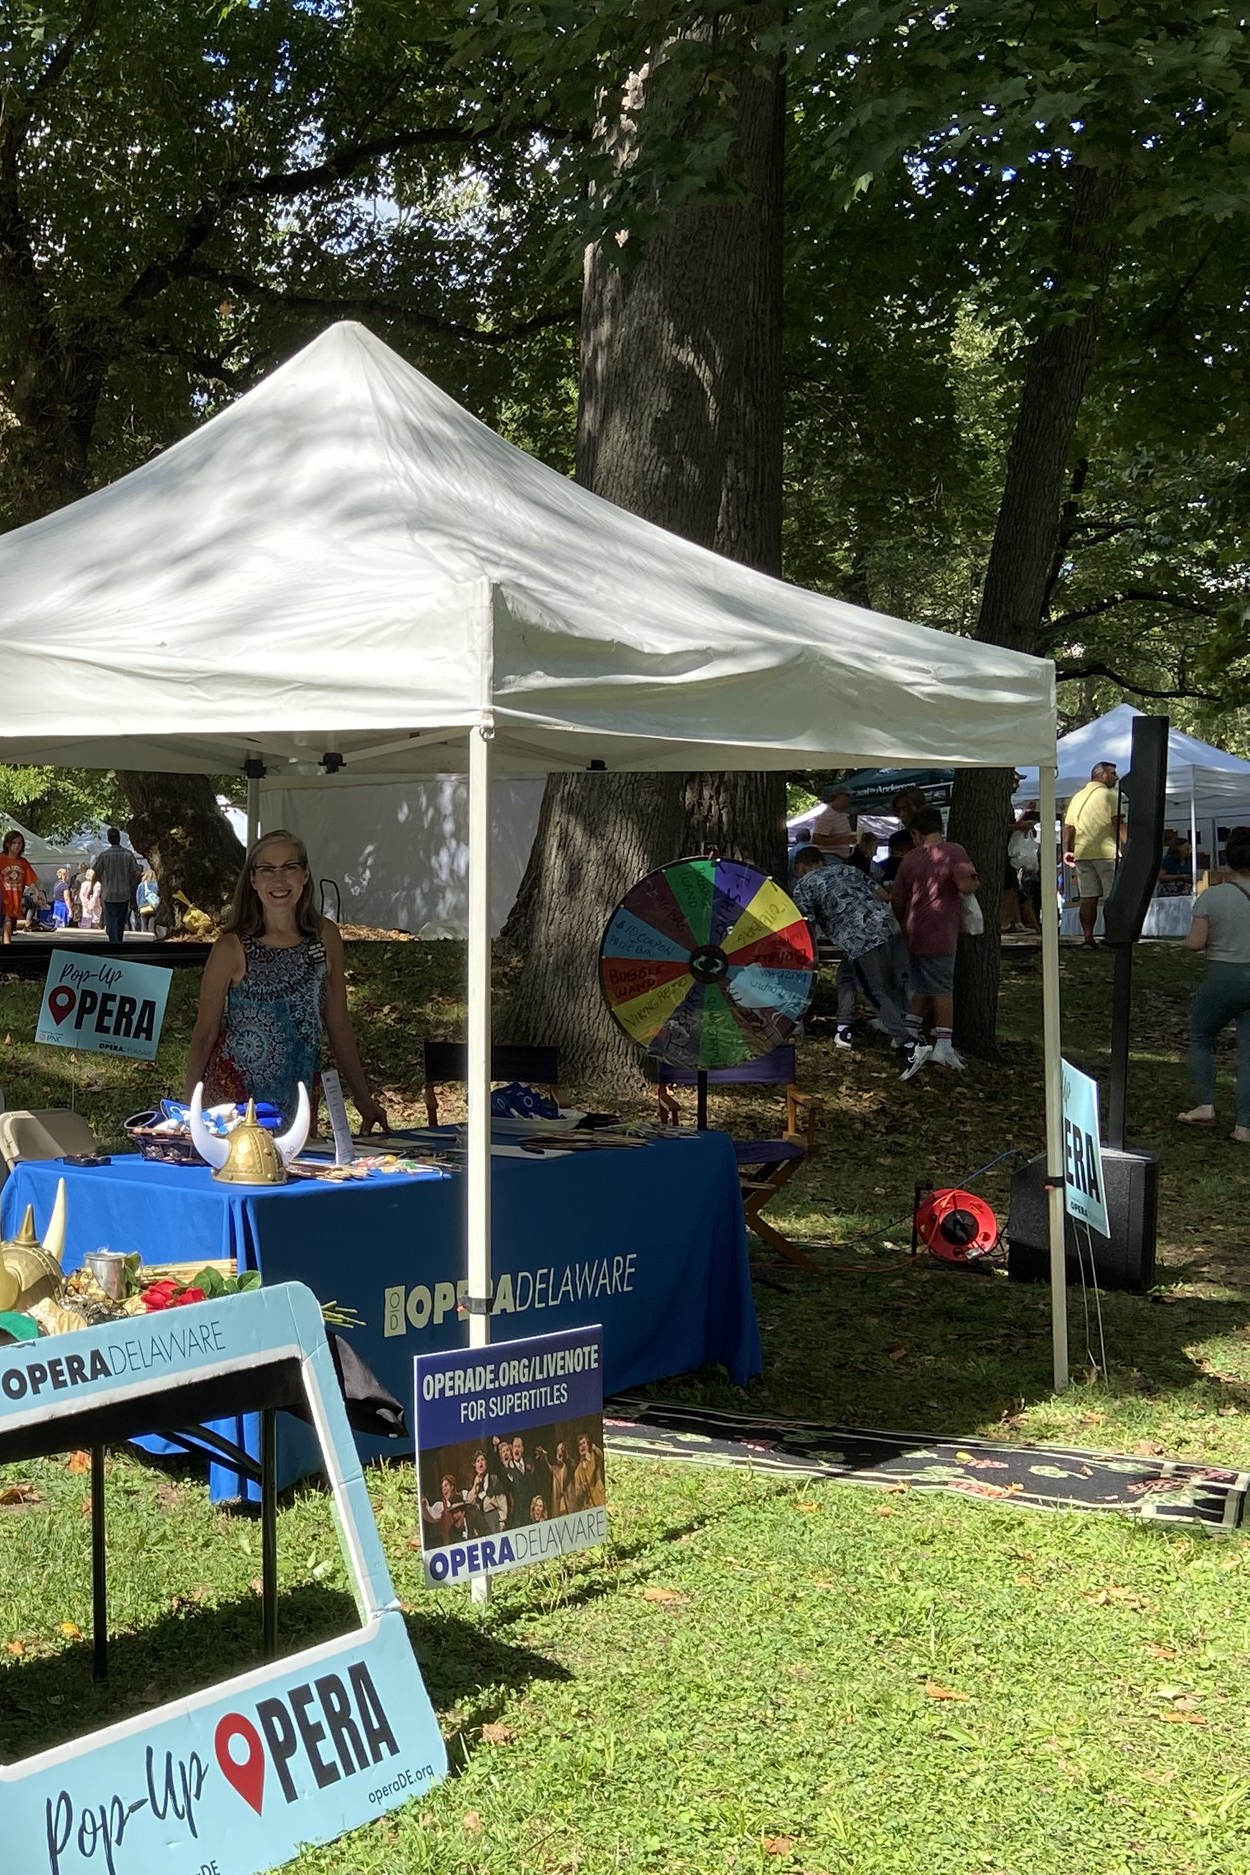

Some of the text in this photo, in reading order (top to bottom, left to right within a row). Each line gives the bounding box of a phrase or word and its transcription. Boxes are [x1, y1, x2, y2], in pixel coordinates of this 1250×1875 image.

[59, 963, 124, 990] Pop-Up
[609, 963, 664, 985] BUBBLE
[613, 978, 657, 999] WAND
[623, 1000, 661, 1028] VIKING
[1065, 1117, 1101, 1204] ERA
[406, 1253, 638, 1330] OPADELAWARE
[422, 1344, 599, 1401] OPERADE.ORG/LIVENOTE
[460, 1384, 569, 1424] FOR SUPERTITLES
[368, 1764, 435, 1805] operaDE.org
[46, 1746, 209, 1875] Pop-Up
